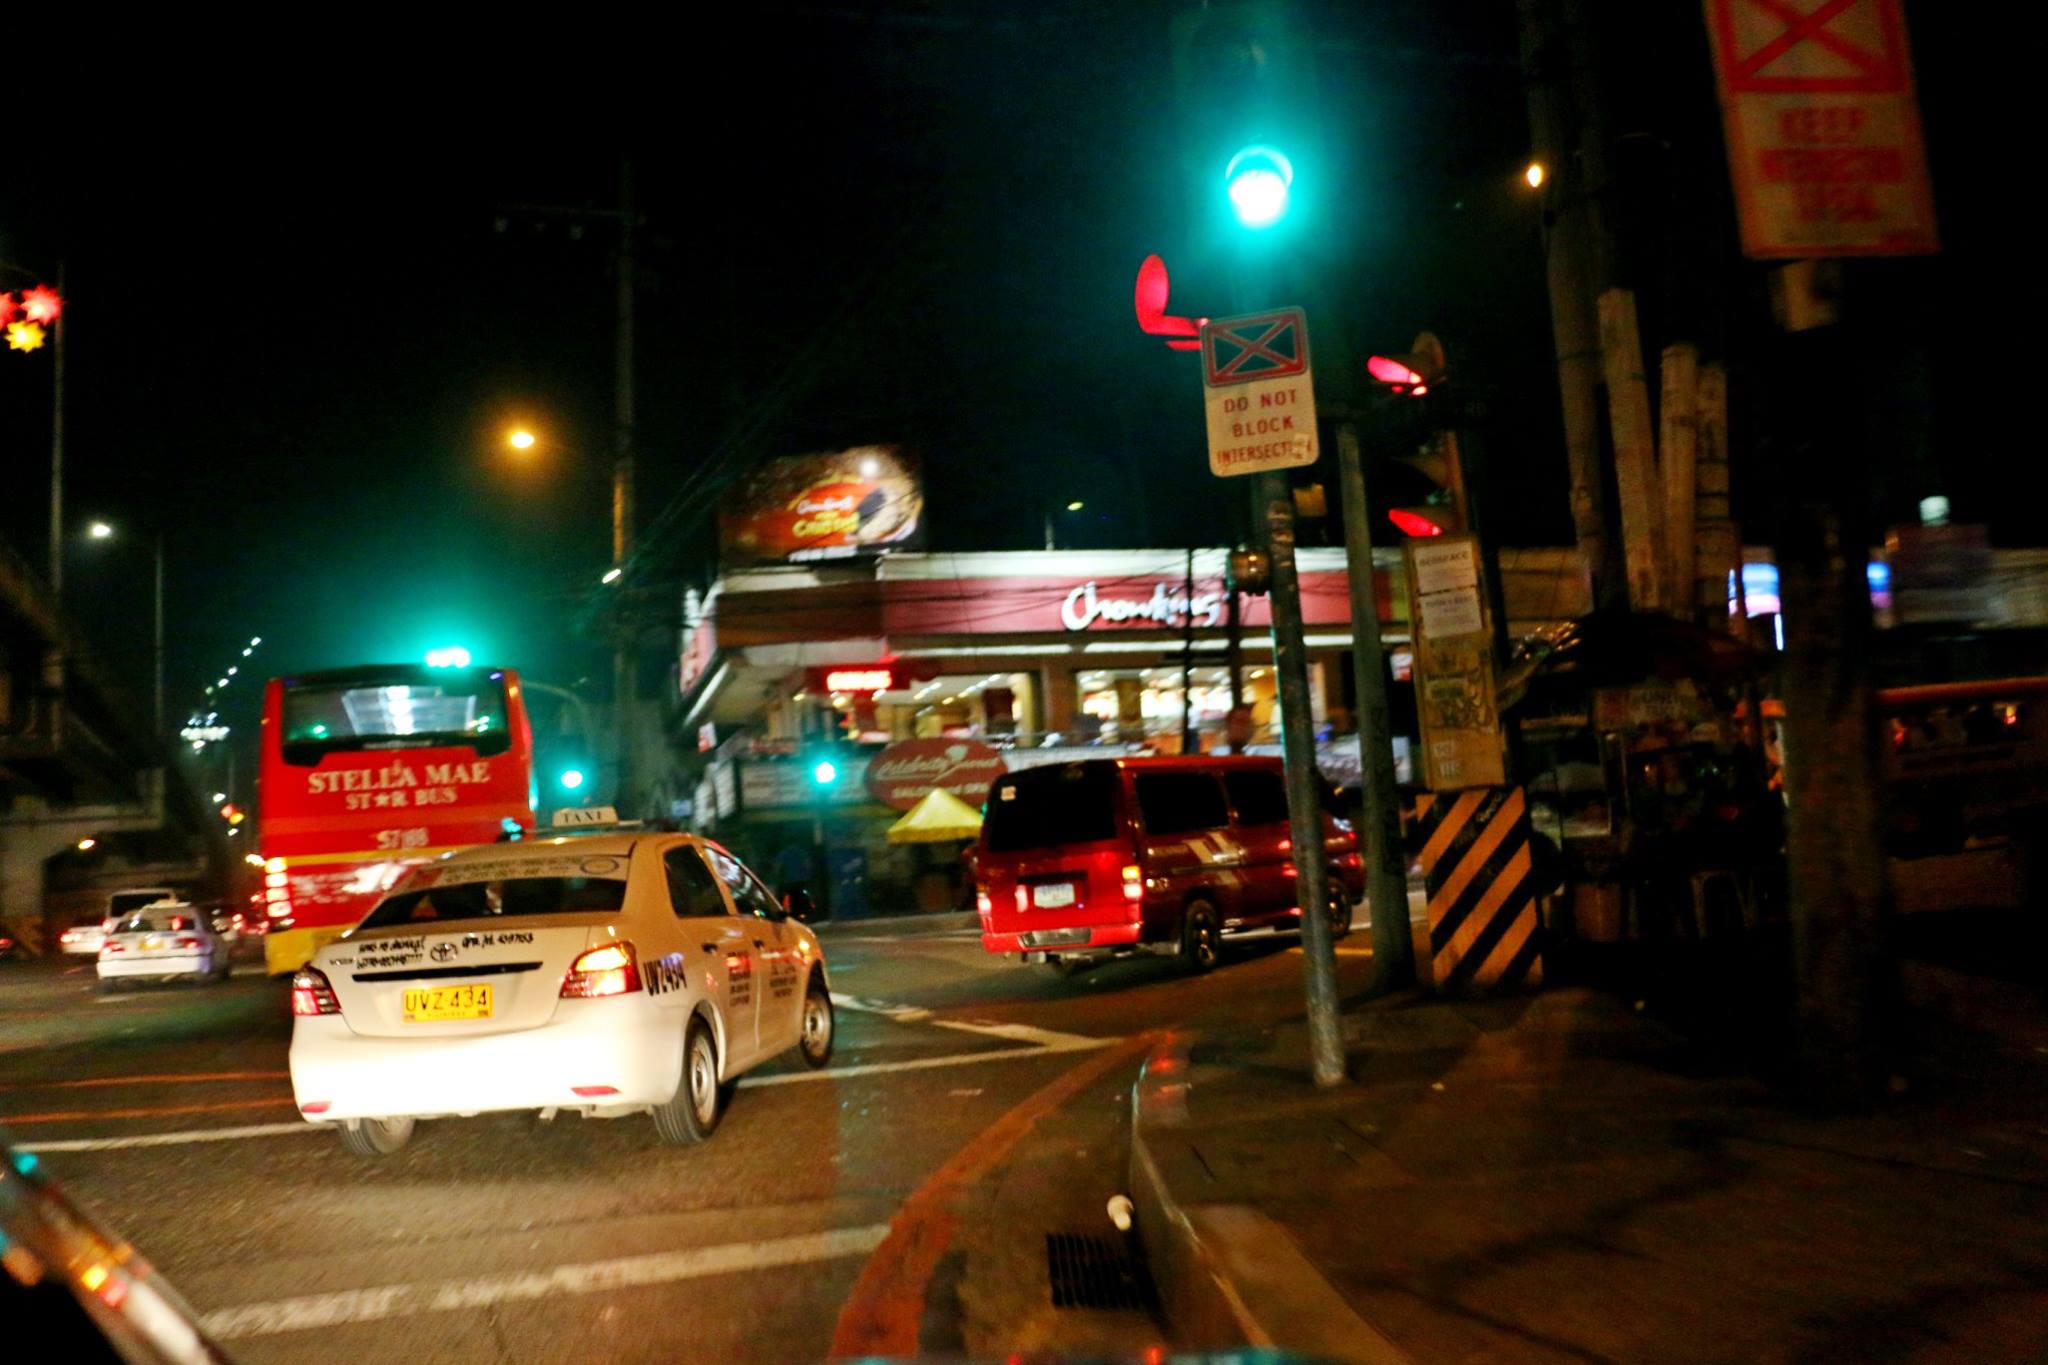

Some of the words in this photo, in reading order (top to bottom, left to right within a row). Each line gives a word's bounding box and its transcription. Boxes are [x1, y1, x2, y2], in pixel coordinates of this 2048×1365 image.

[1224, 397, 1249, 413] DO
[1260, 389, 1297, 408] NOT
[1232, 415, 1294, 438] BLOCK
[425, 762, 492, 786] MAE
[449, 988, 487, 1009] 434
